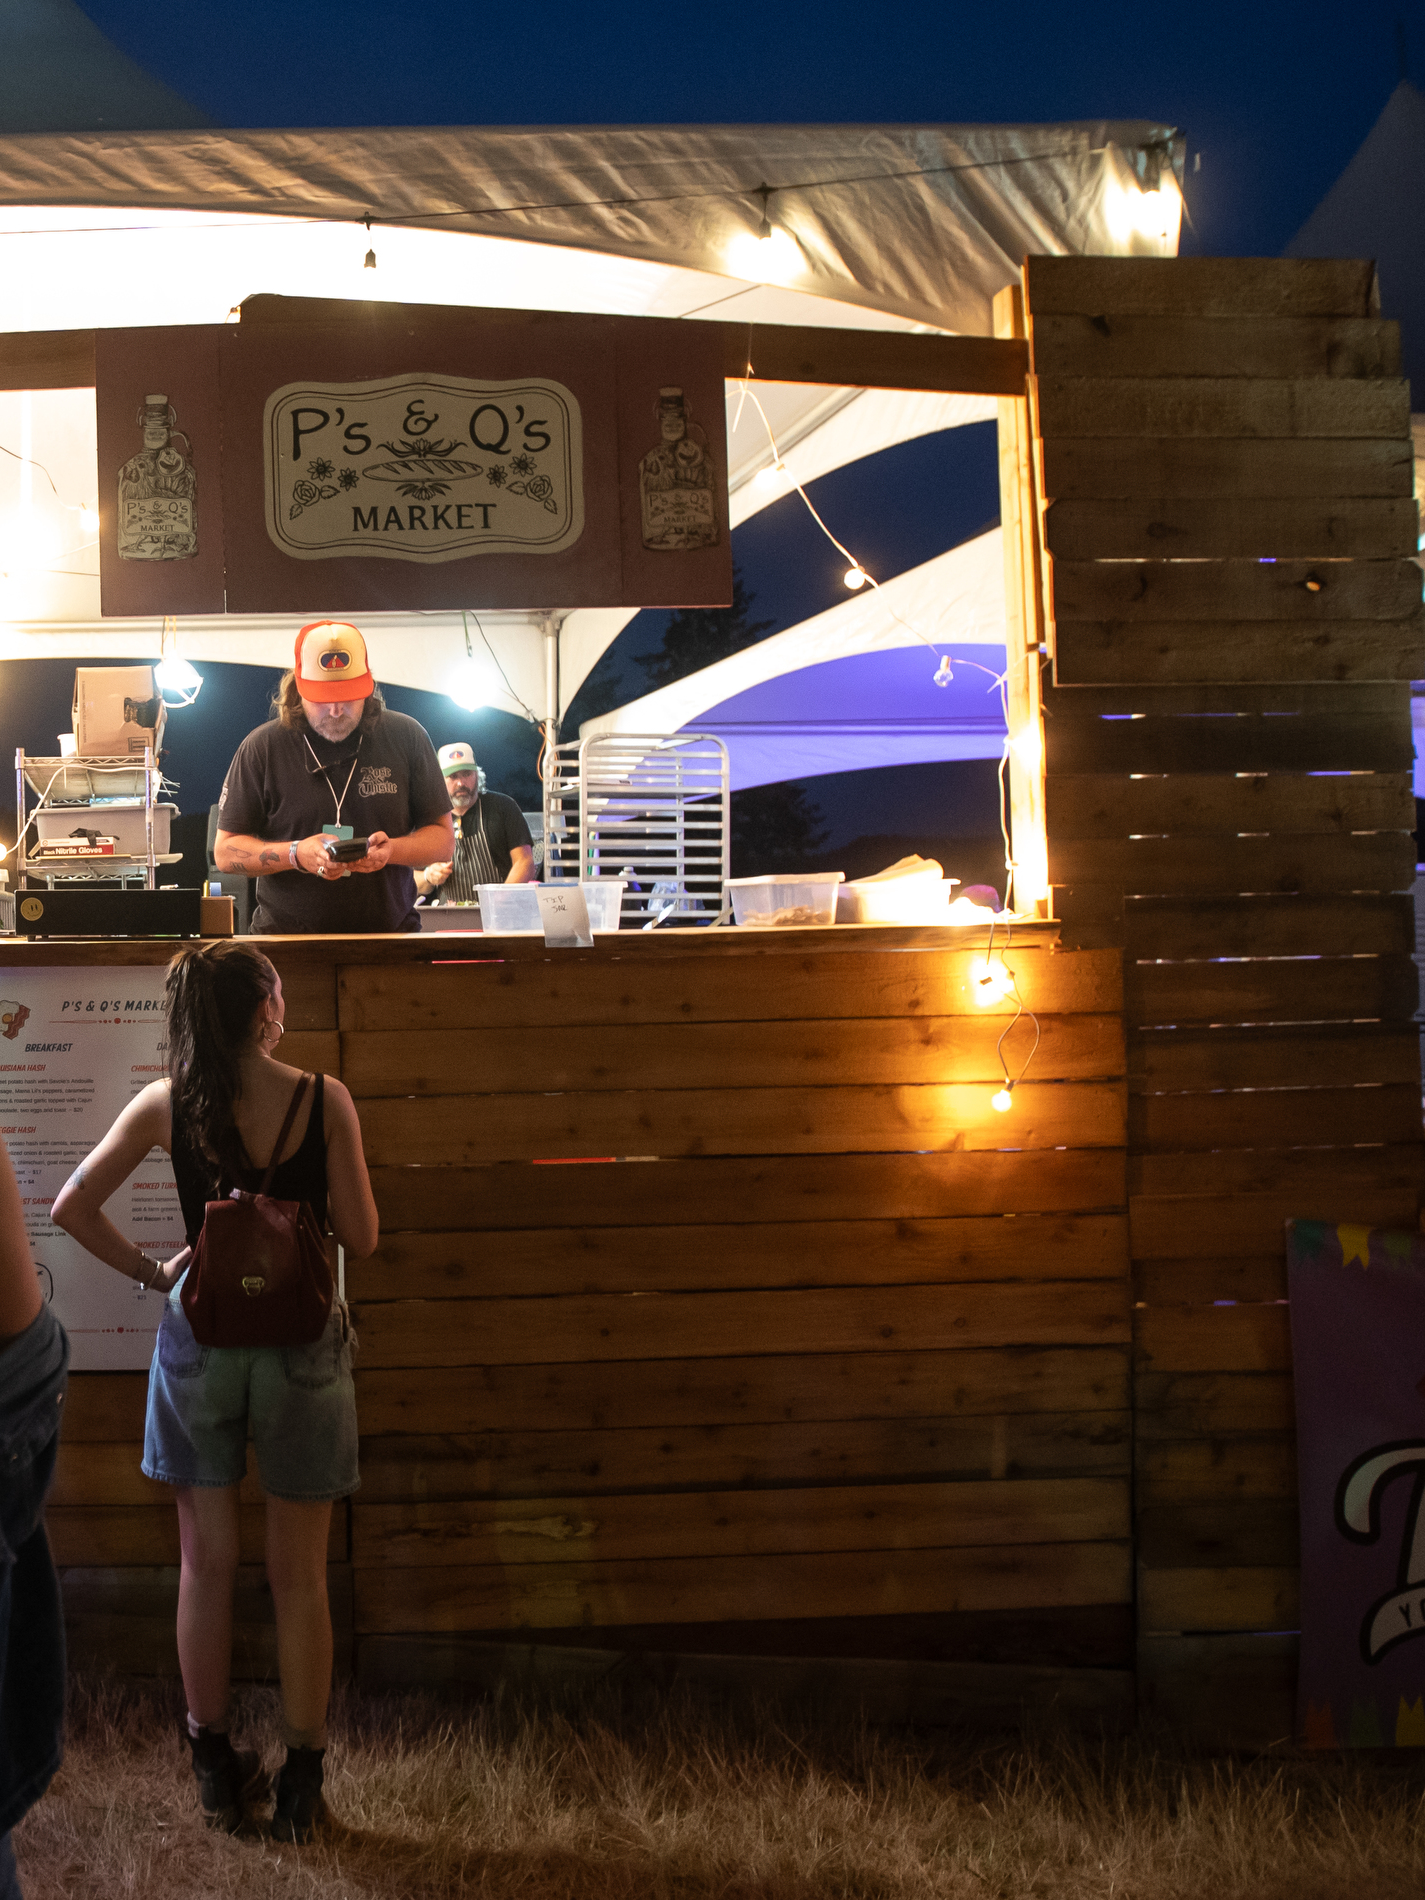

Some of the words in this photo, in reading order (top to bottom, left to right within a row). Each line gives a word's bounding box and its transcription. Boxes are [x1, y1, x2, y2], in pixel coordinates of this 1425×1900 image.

[290, 406, 373, 462] P's
[402, 398, 440, 437] &
[468, 403, 552, 456] Q's
[126, 501, 147, 517] P's
[167, 501, 189, 517] Q's
[351, 502, 498, 533] MARKET
[140, 524, 176, 533] MARKET
[55, 847, 77, 855] Nitrile
[78, 846, 103, 854] Gloves
[61, 1000, 82, 1012] P'S
[85, 1001, 95, 1012] &
[100, 1001, 120, 1012] Q'S
[124, 1000, 167, 1012] MARKE
[25, 1043, 73, 1053] BREAKFAST
[27, 1064, 46, 1072] HASH
[17, 1126, 37, 1134] HASH
